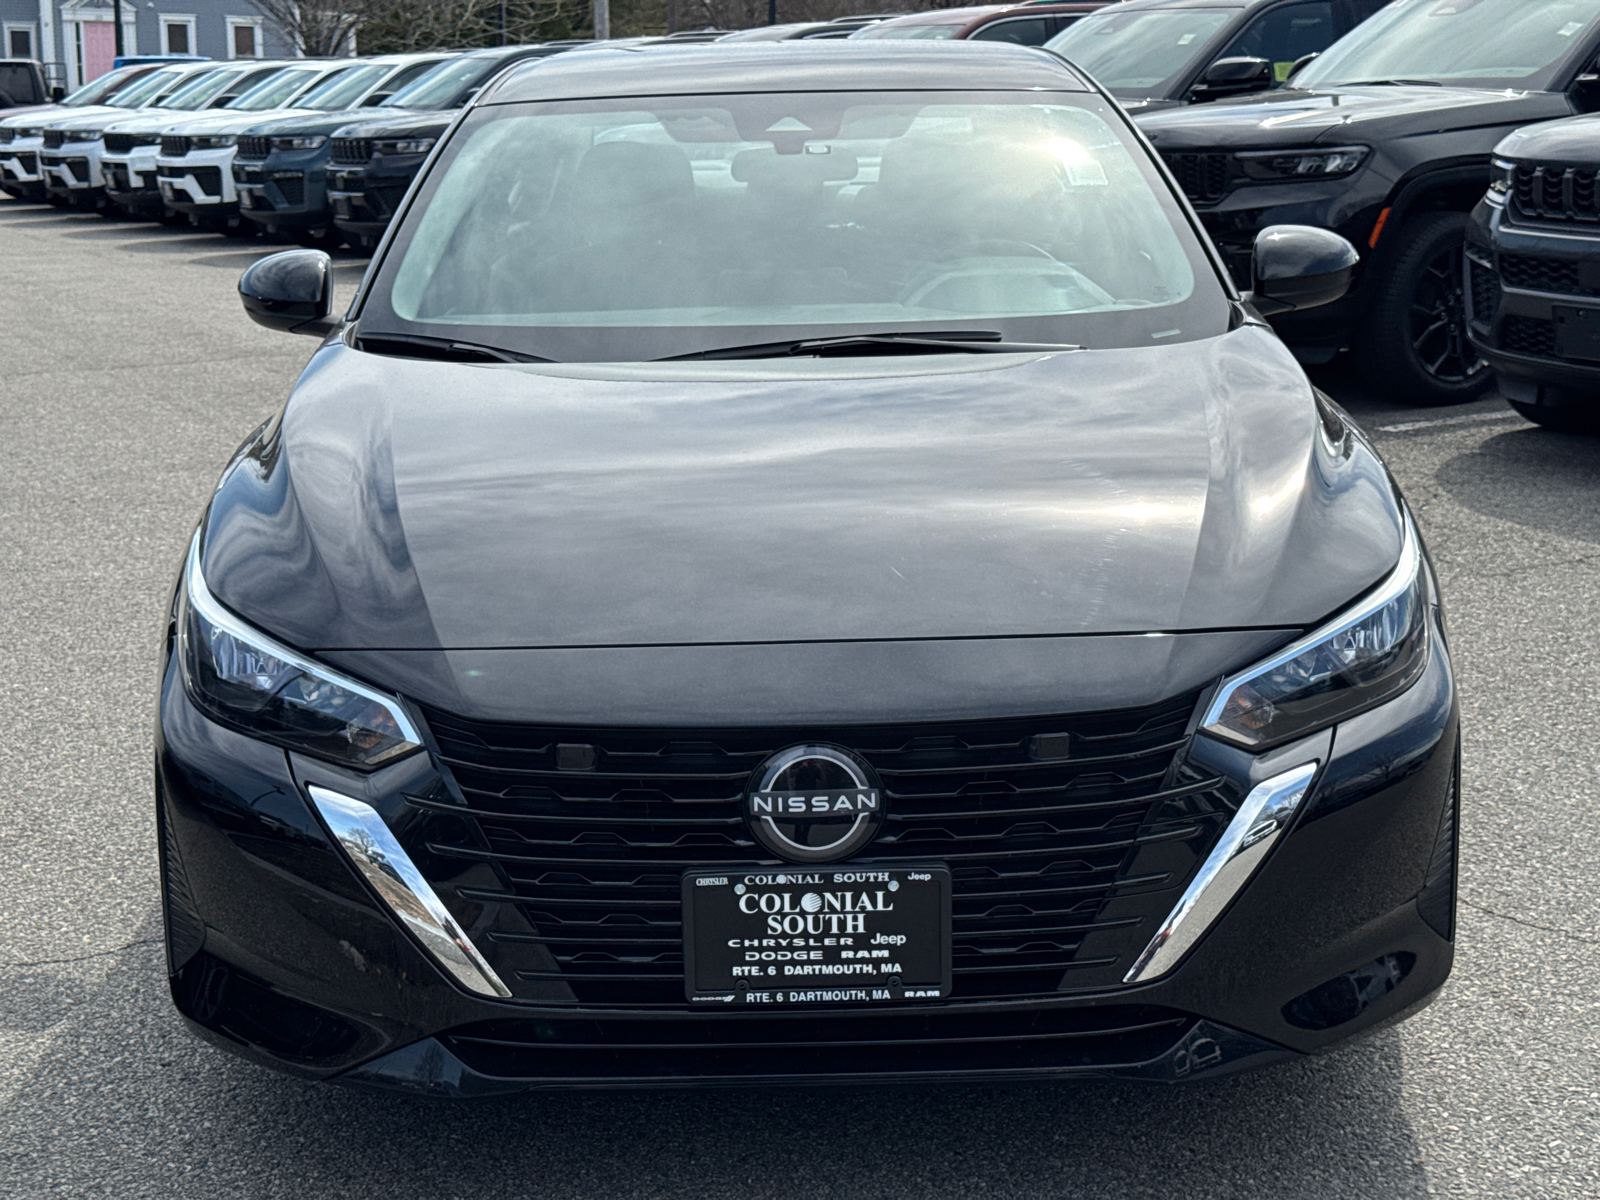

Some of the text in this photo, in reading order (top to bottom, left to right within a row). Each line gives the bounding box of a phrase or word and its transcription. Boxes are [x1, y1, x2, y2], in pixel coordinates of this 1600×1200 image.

[753, 792, 876, 813] NISSAN
[696, 878, 729, 886] CHRYSLER
[744, 872, 890, 885] COLONIAL SOUTH
[907, 872, 932, 881] Jeep
[738, 891, 893, 913] COLONIAL
[767, 914, 866, 935] SOUTH
[727, 933, 907, 947] CHRYSLER Jeep
[745, 950, 889, 961] DODGE RAM
[732, 963, 903, 976] RTE. 6 DARTMOUTH, MA
[746, 990, 891, 1003] RTE. 6 DARTMOUTH, MA
[904, 990, 941, 998] RAM
